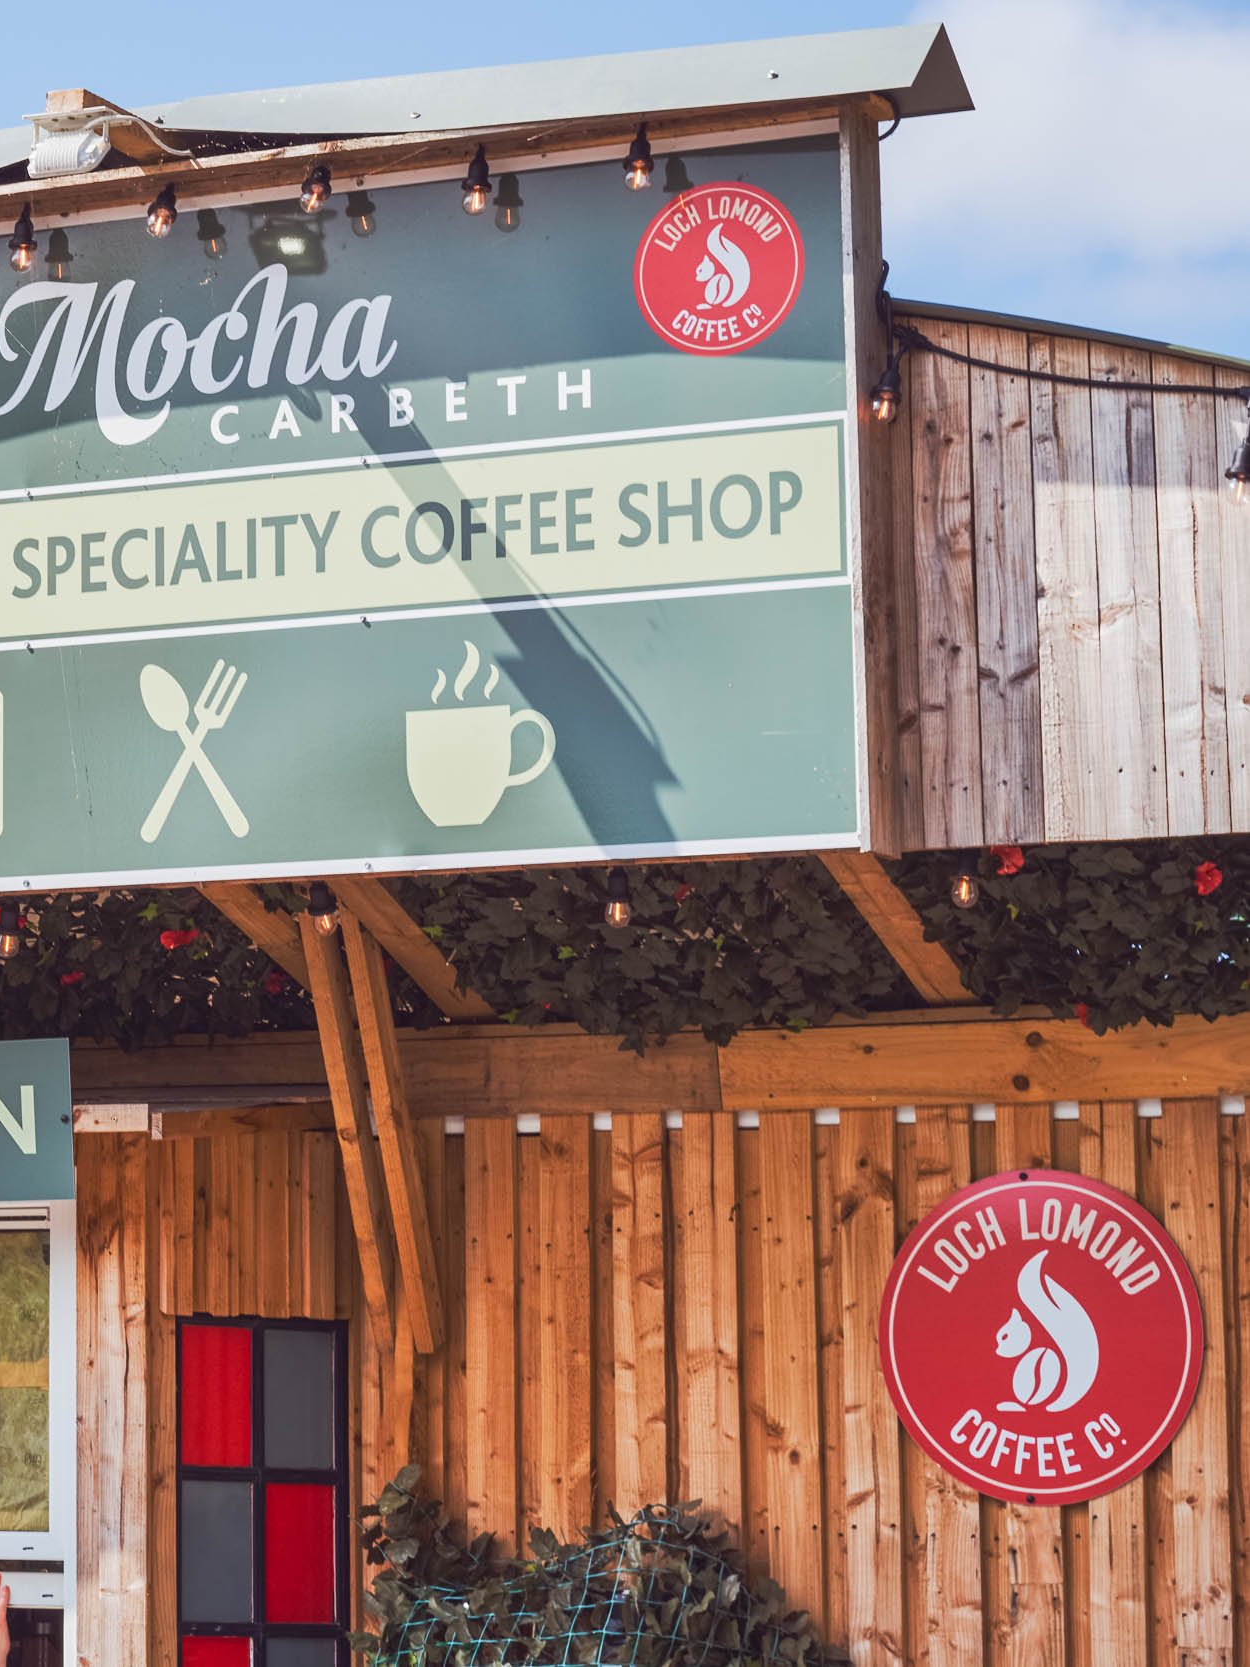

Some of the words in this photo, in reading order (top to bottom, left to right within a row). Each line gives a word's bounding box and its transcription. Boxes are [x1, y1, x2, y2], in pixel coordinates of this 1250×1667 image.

[654, 204, 701, 252] LOCH
[707, 196, 782, 242] LOMOND
[671, 309, 742, 342] COFFEE
[210, 368, 594, 445] CARBETH
[11, 510, 341, 600] SPECIALITY
[360, 487, 595, 569] COFFEE
[618, 470, 803, 548] SHOP
[917, 1206, 1007, 1293] LOCH
[1018, 1198, 1161, 1295] LOMOND
[950, 1408, 1082, 1477] COFFEE
